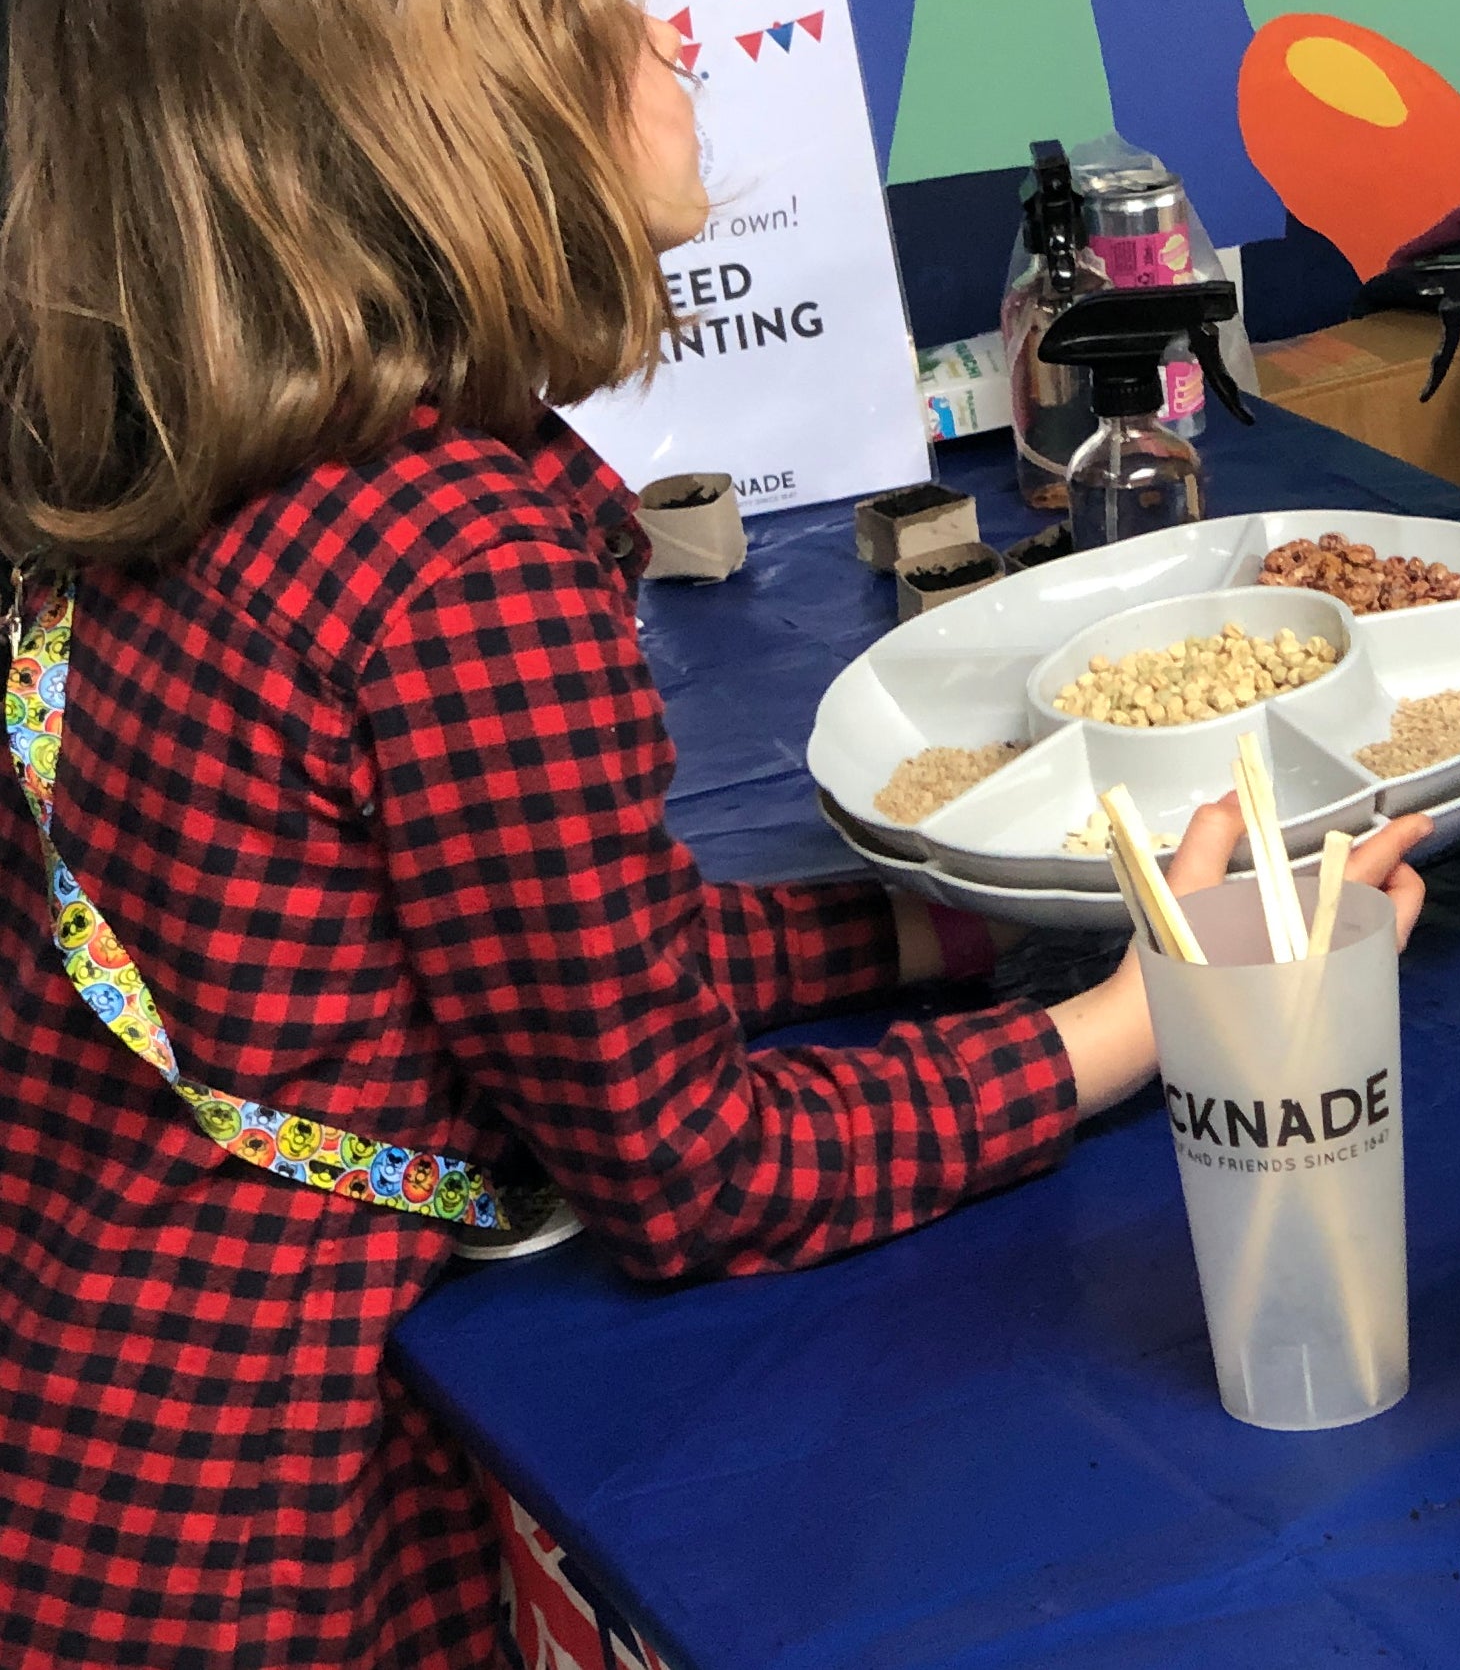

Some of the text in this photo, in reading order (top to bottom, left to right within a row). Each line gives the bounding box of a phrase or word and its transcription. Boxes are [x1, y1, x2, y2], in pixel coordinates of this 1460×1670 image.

[731, 194, 799, 237] own!
[661, 301, 824, 364] NTING
[1166, 1068, 1390, 1148] CKNADE
[1218, 1156, 1297, 1174] FRIENDS
[1303, 1144, 1359, 1170] SINCE
